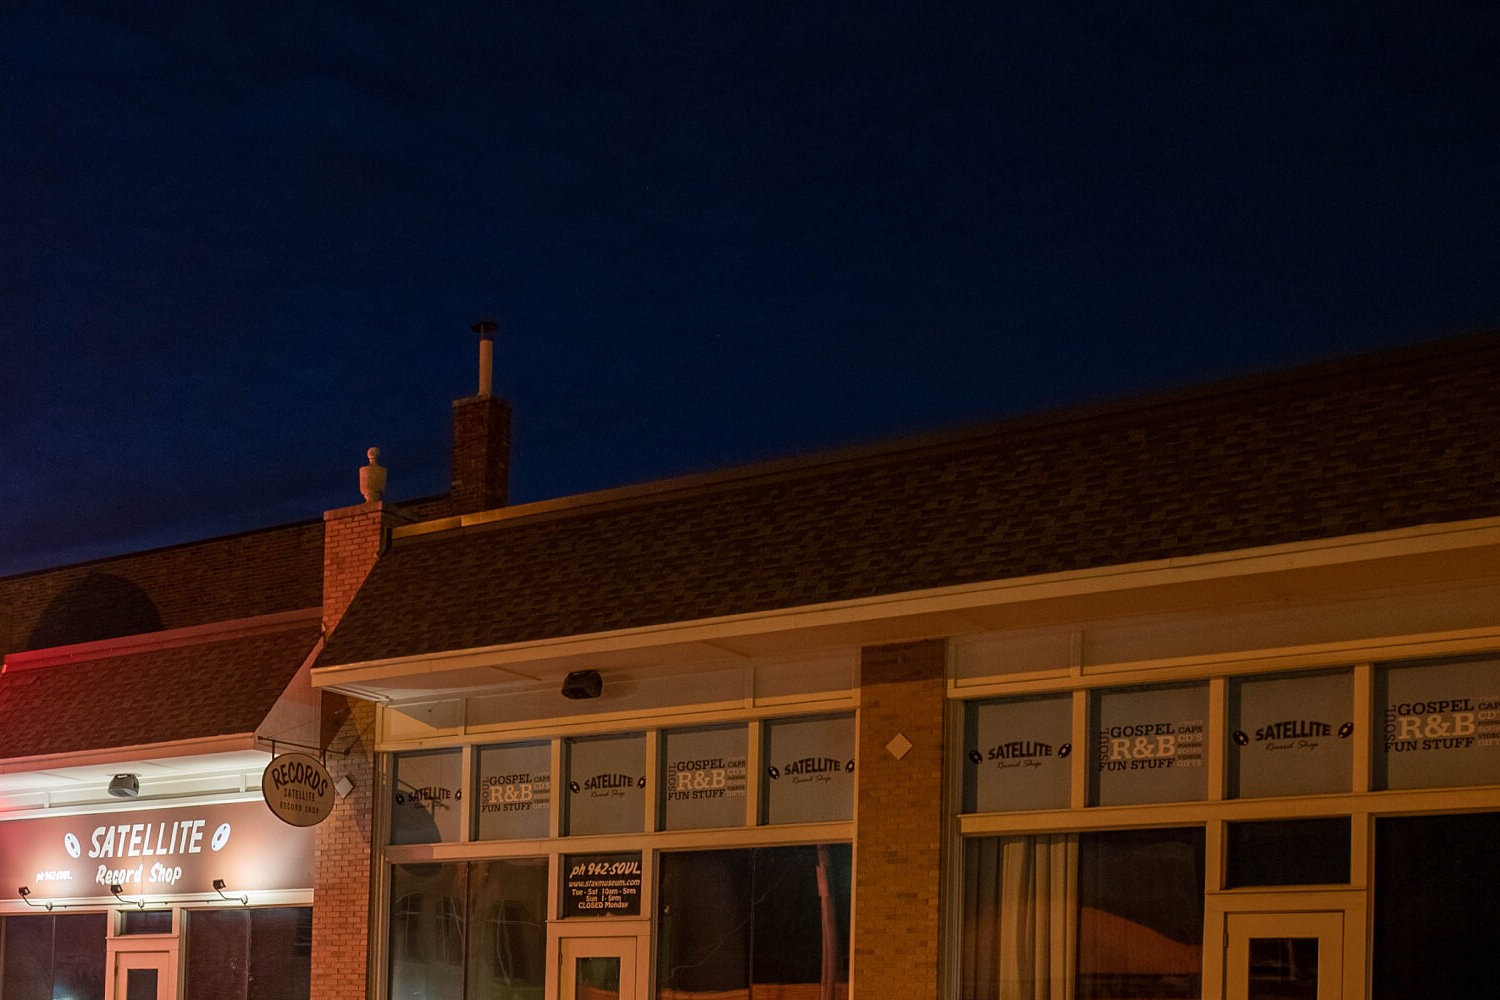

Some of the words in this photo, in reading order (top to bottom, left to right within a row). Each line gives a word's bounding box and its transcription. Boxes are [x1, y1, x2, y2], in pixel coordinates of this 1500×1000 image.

[1398, 699, 1474, 716] GOSPEL
[1478, 702, 1500, 710] CAP
[1384, 705, 1397, 742] SOUL
[1478, 711, 1500, 720] CD'
[1110, 723, 1175, 738] GOSPEL
[1178, 725, 1203, 734] CAPS
[1255, 720, 1332, 742] SATELLITE
[1398, 712, 1475, 740] R&B
[988, 741, 1052, 760] SATELLITE
[1099, 728, 1109, 761] SOUL
[1109, 735, 1175, 760] R&B
[1384, 741, 1418, 753] FUN
[1422, 736, 1475, 751] STUFF
[677, 758, 725, 772] GOSPEL
[727, 760, 746, 768] CAPS
[784, 757, 841, 775] SATELLITE
[1098, 761, 1127, 772] FUN
[1130, 758, 1175, 770] STUFF
[271, 761, 329, 798] RECORDS
[490, 773, 532, 786] GOSPEL
[534, 775, 550, 783] CAPS
[584, 774, 634, 790] SATELLITE
[668, 763, 676, 792] SOUL
[677, 767, 725, 791] R&B
[284, 787, 316, 802] SATELLITE
[408, 787, 452, 802] SATELLITE
[482, 777, 490, 804] SOUL
[490, 783, 533, 803] R&B
[668, 791, 689, 801] FUN
[692, 788, 725, 799] STUFF
[280, 801, 302, 812] RECORD
[305, 805, 319, 815] SHOP
[482, 804, 501, 813] FUN
[503, 801, 532, 812] STUFF
[88, 819, 206, 859] SATELLITE
[96, 863, 144, 886] Record
[149, 862, 182, 886] Shop
[569, 863, 586, 879] ph
[569, 880, 641, 888] www.staxmuseum.com
[588, 888, 598, 896] Sat
[604, 901, 629, 909] Monday
